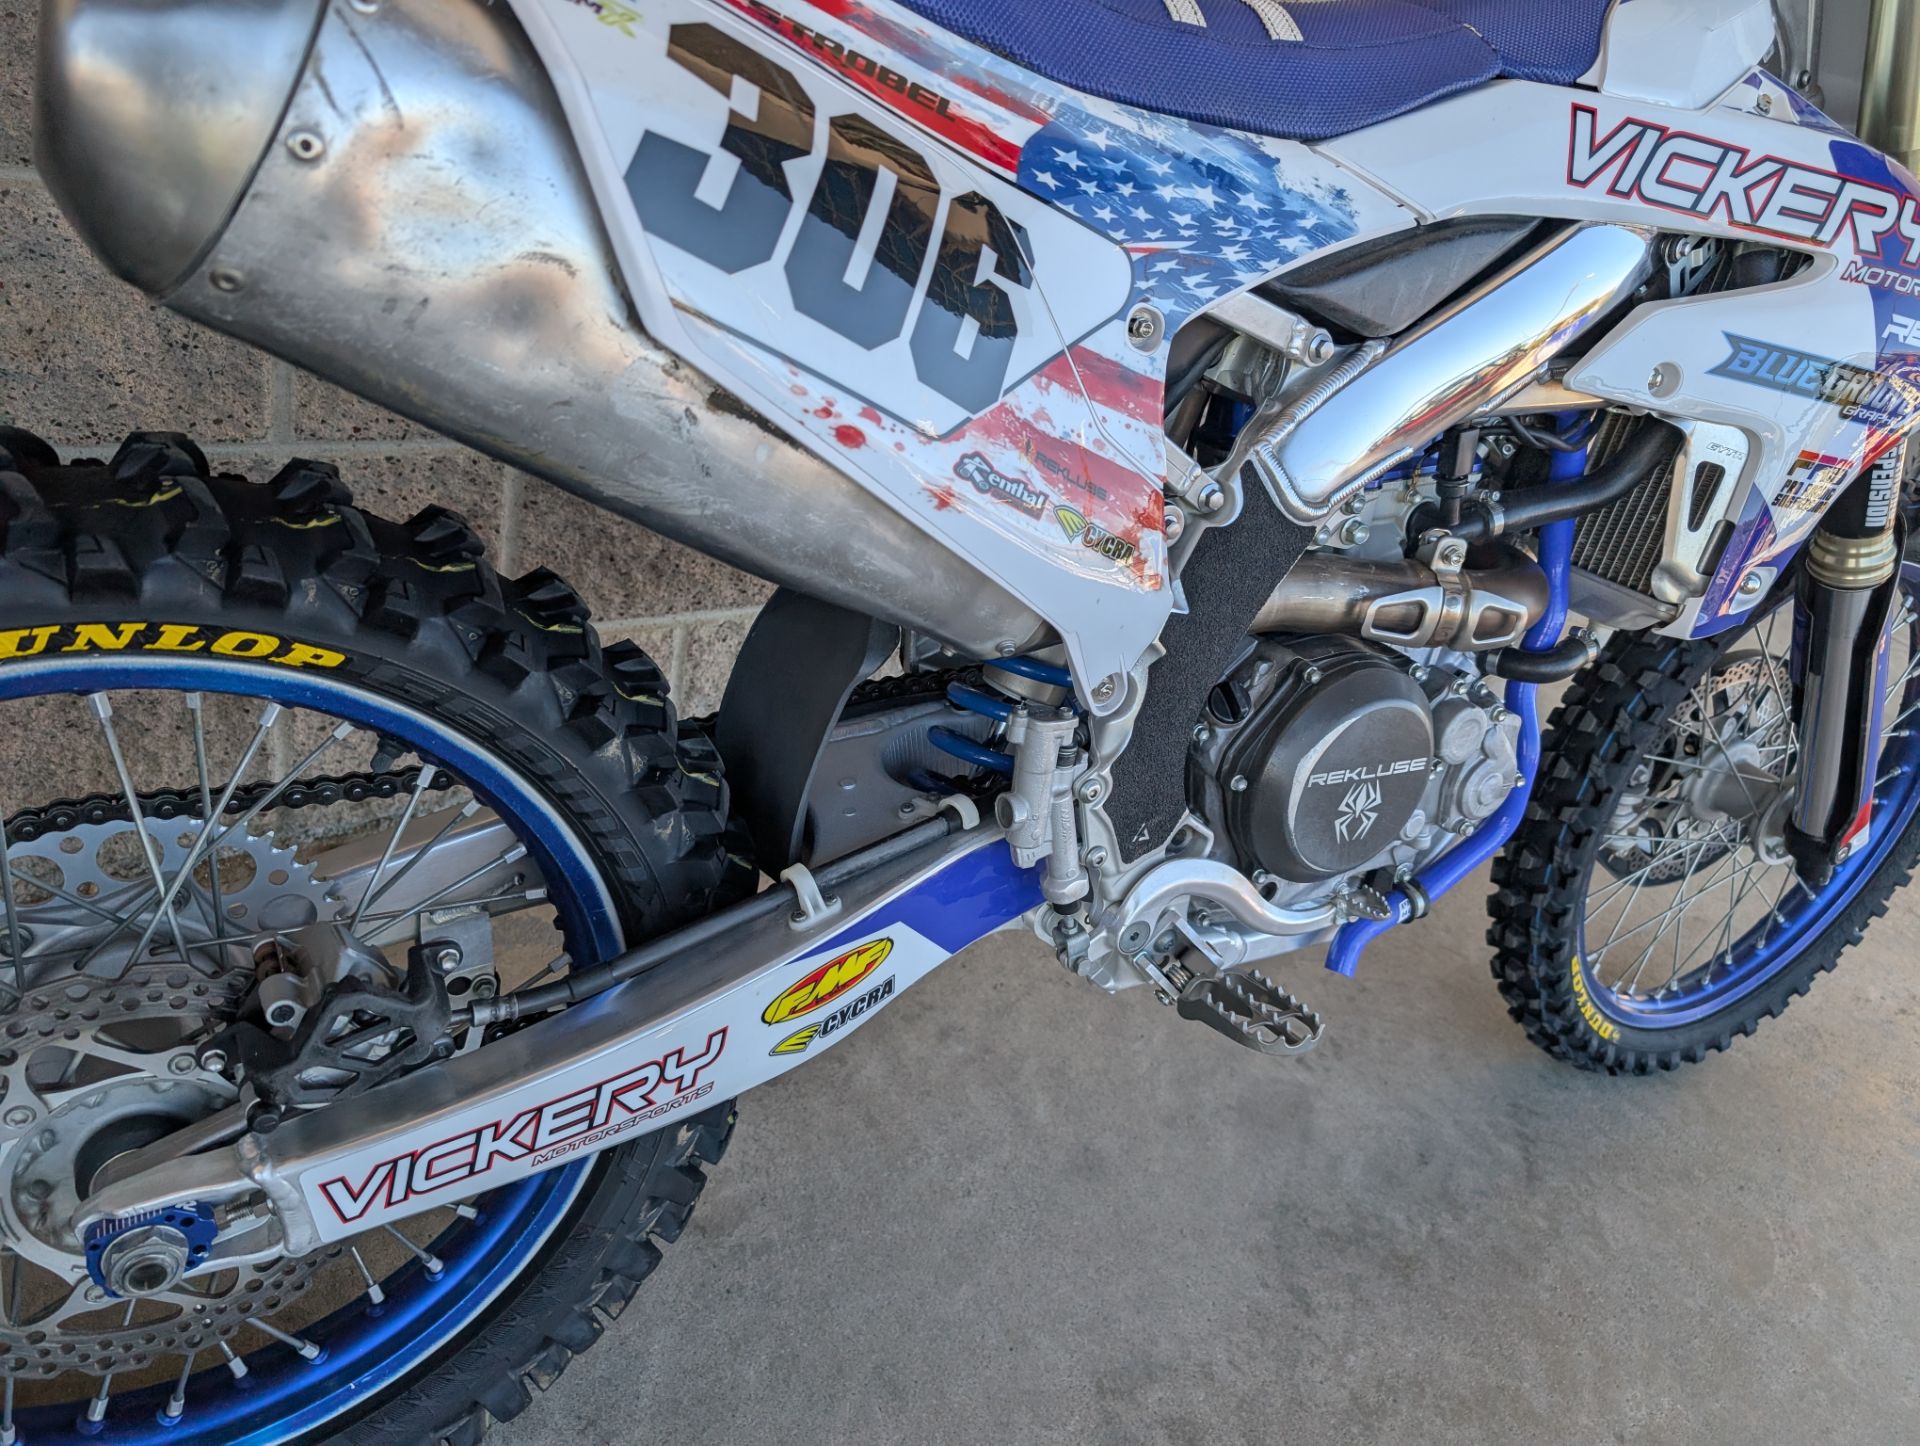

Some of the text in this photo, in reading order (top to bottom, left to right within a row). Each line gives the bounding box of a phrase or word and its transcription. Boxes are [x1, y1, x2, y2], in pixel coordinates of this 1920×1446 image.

[749, 0, 957, 122] STROBEL
[623, 22, 1036, 414] 306
[1081, 522, 1135, 565] CYCRA
[1307, 757, 1428, 788] REKLUSE
[771, 937, 888, 1023] FMF
[819, 975, 896, 1038] CYCRA
[318, 1025, 729, 1224] VICKERY
[531, 1081, 715, 1167] MOTORSPORTS
